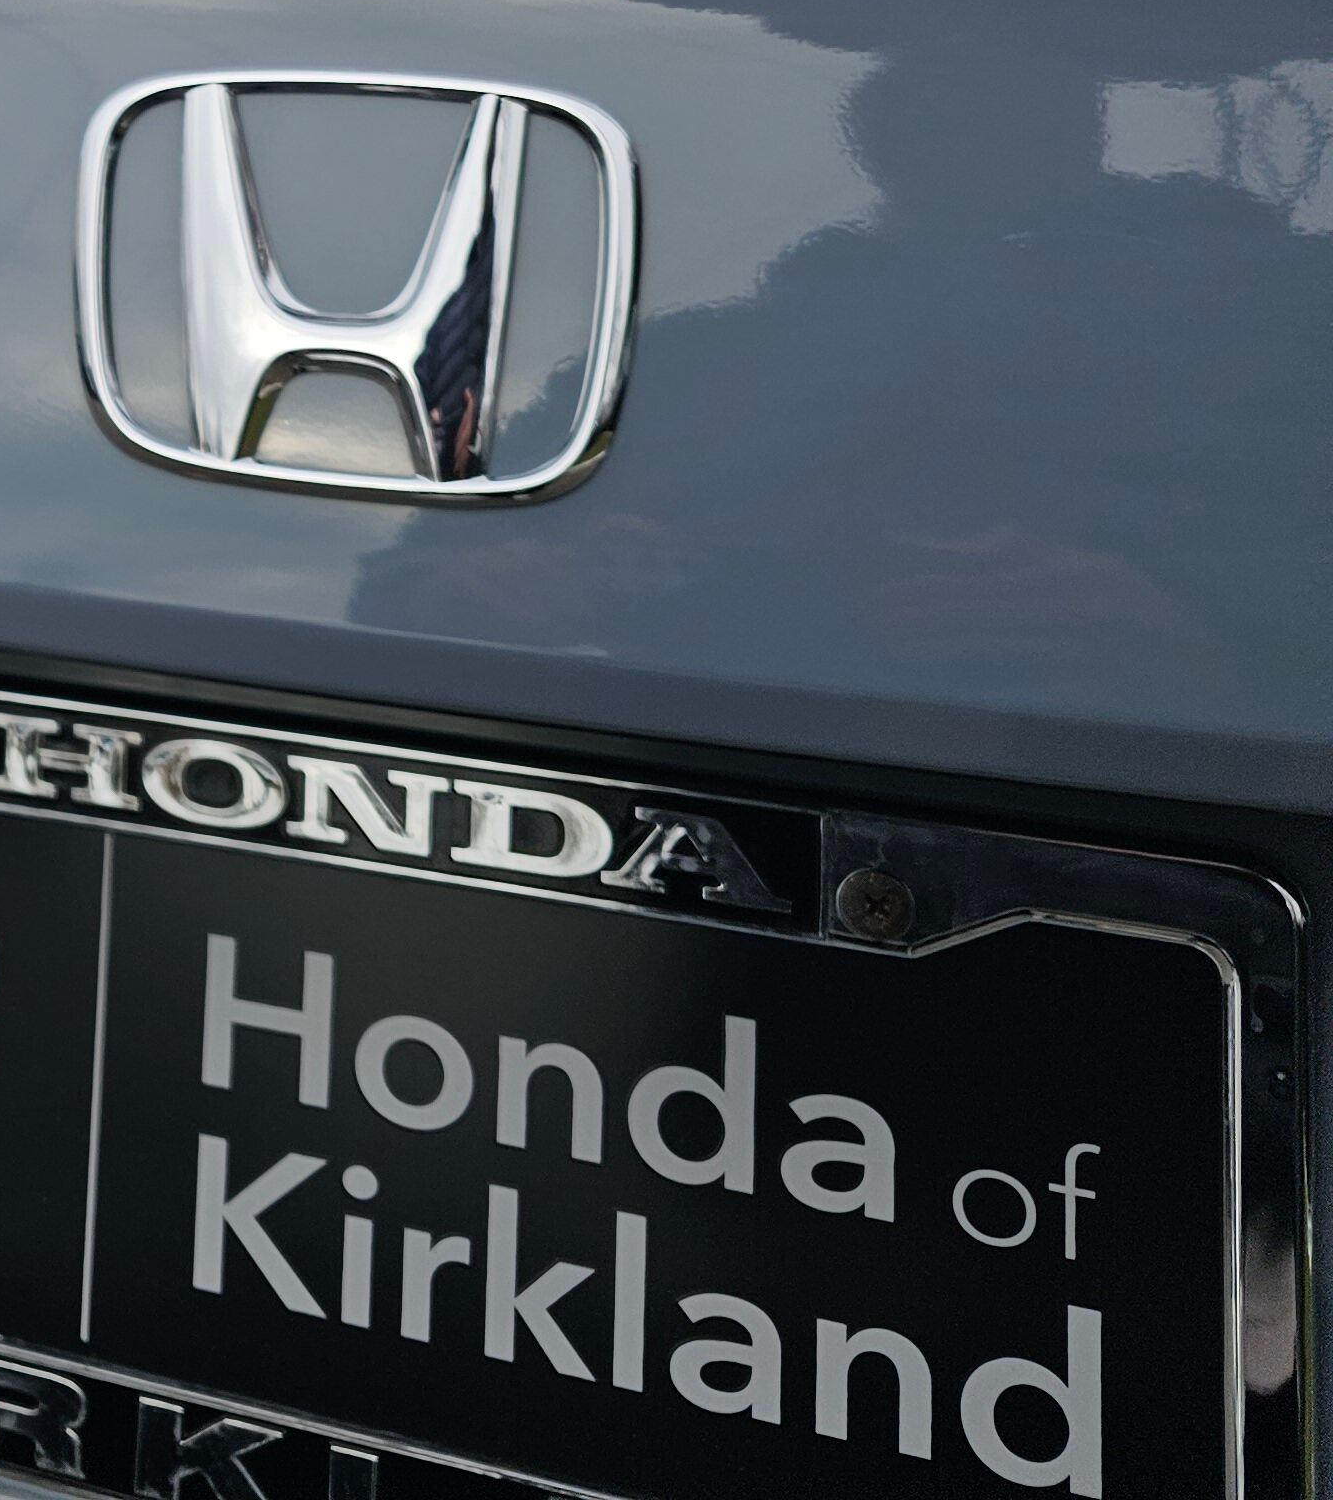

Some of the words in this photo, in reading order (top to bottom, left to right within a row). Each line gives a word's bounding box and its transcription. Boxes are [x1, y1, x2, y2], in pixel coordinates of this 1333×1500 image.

[200, 932, 896, 1223] Honda
[951, 1142, 1102, 1261] of
[192, 1132, 1104, 1500] Kirkland
